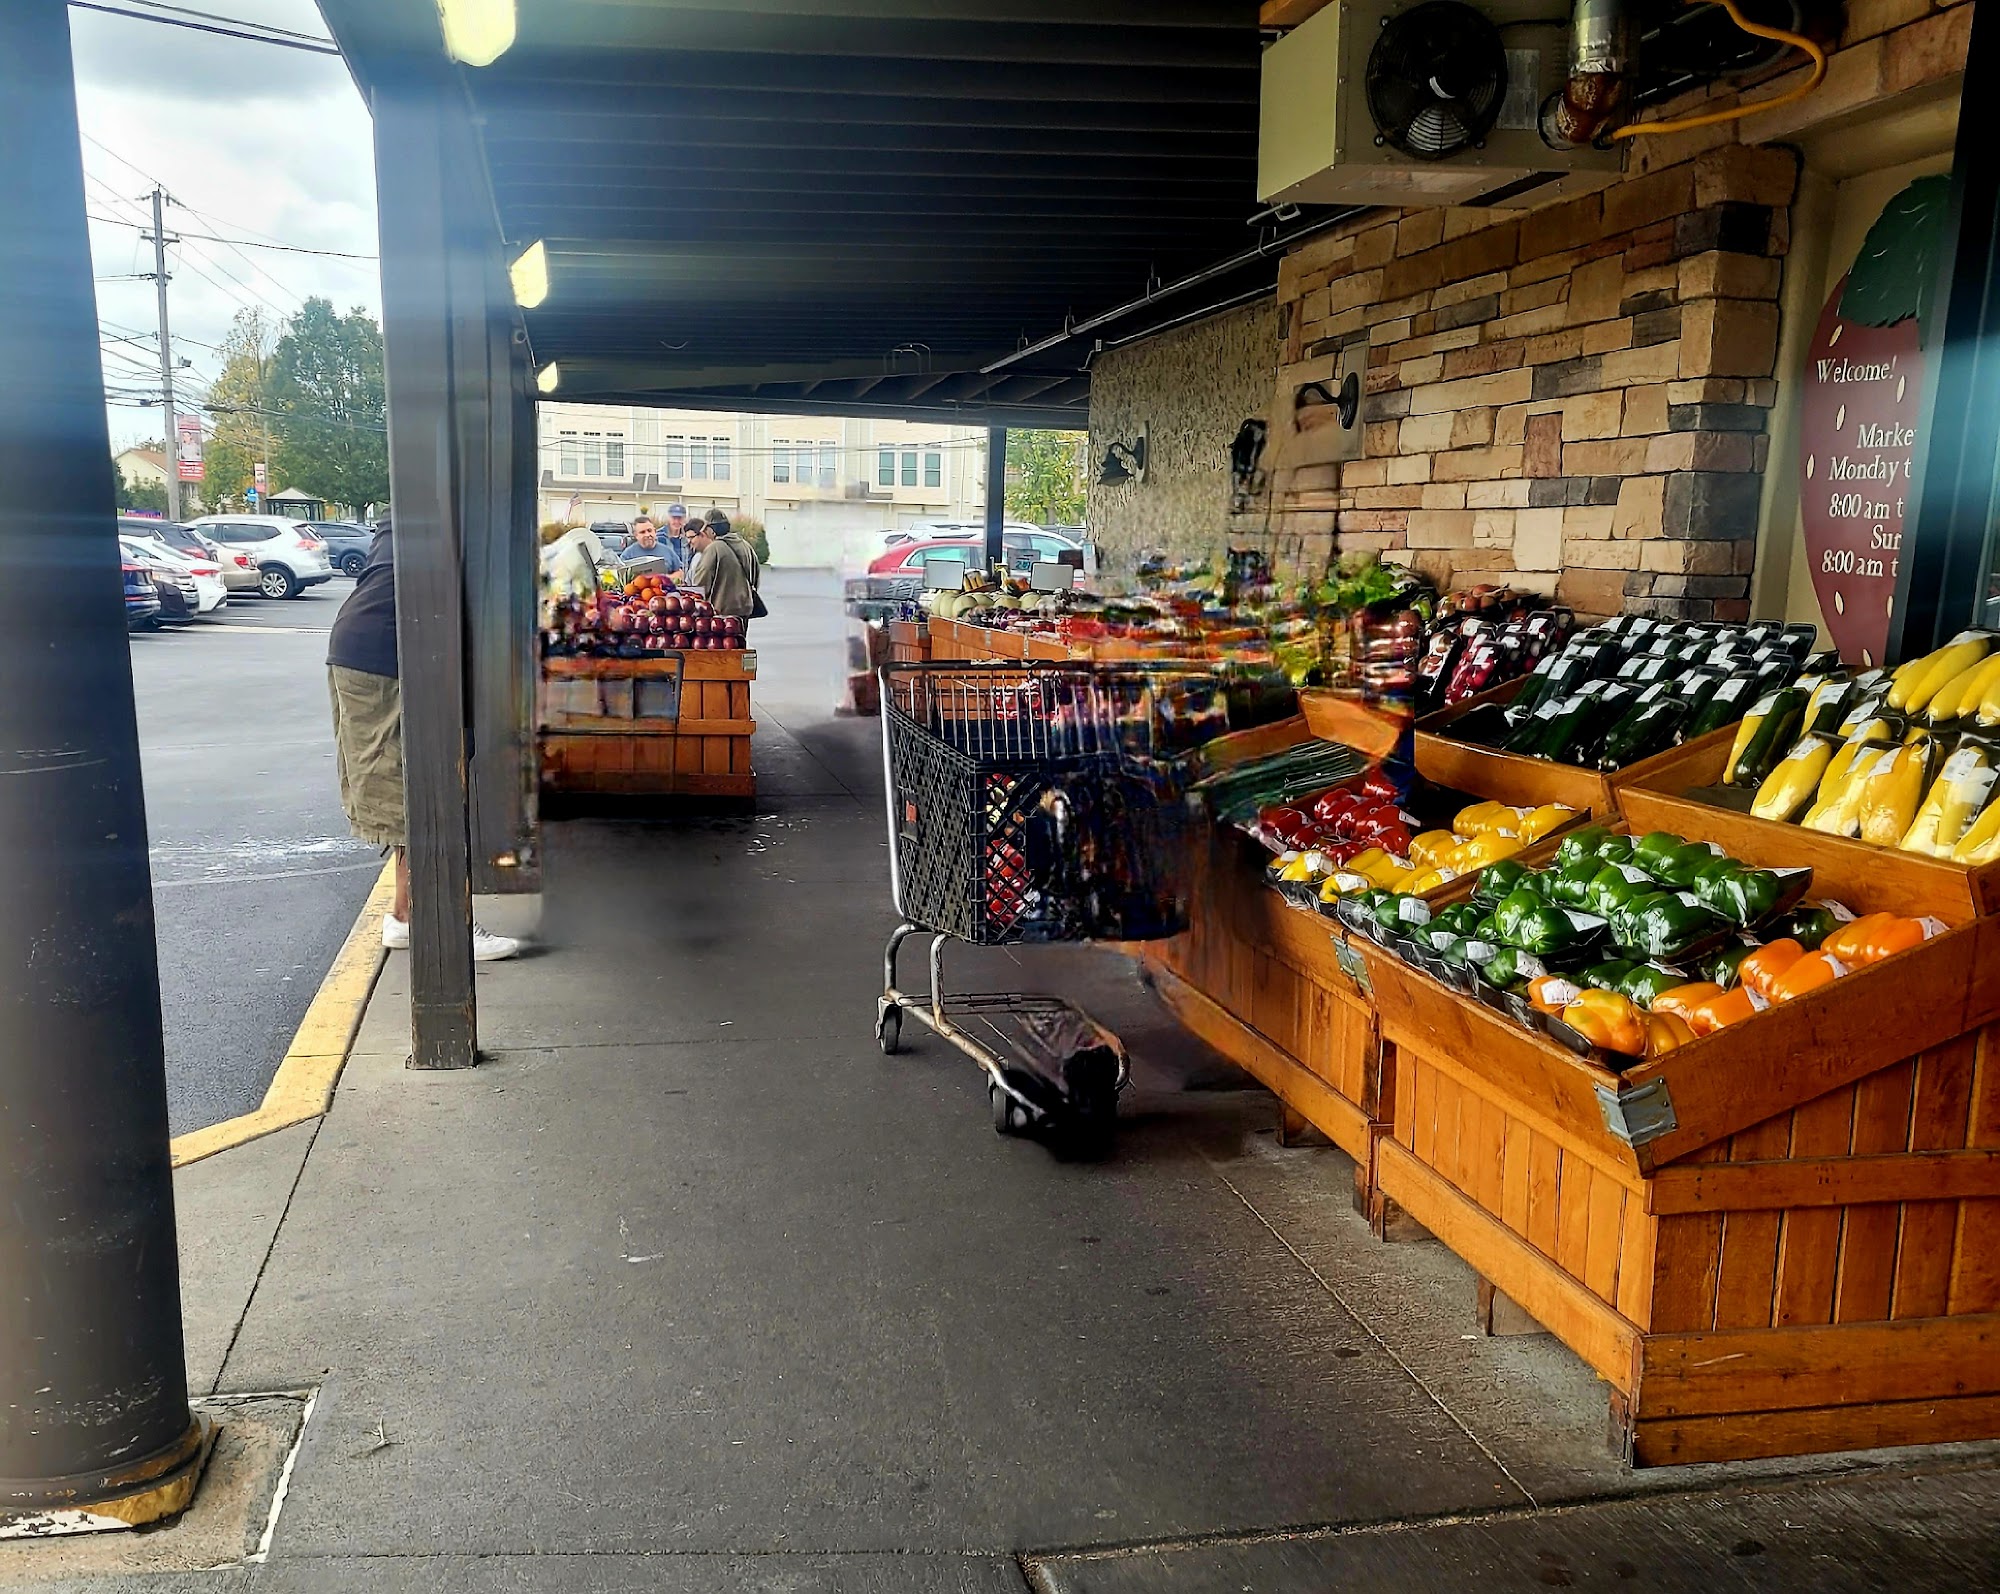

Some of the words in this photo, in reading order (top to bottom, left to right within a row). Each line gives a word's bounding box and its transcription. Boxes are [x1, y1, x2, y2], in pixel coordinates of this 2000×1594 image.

[1816, 356, 1896, 383] Welcome!
[1857, 422, 1917, 448] Marke
[1828, 455, 1899, 487] Monday
[1829, 494, 1861, 518] 8:00
[1863, 501, 1890, 519] am
[1822, 550, 1854, 573] 8:00
[1856, 557, 1883, 577] am
